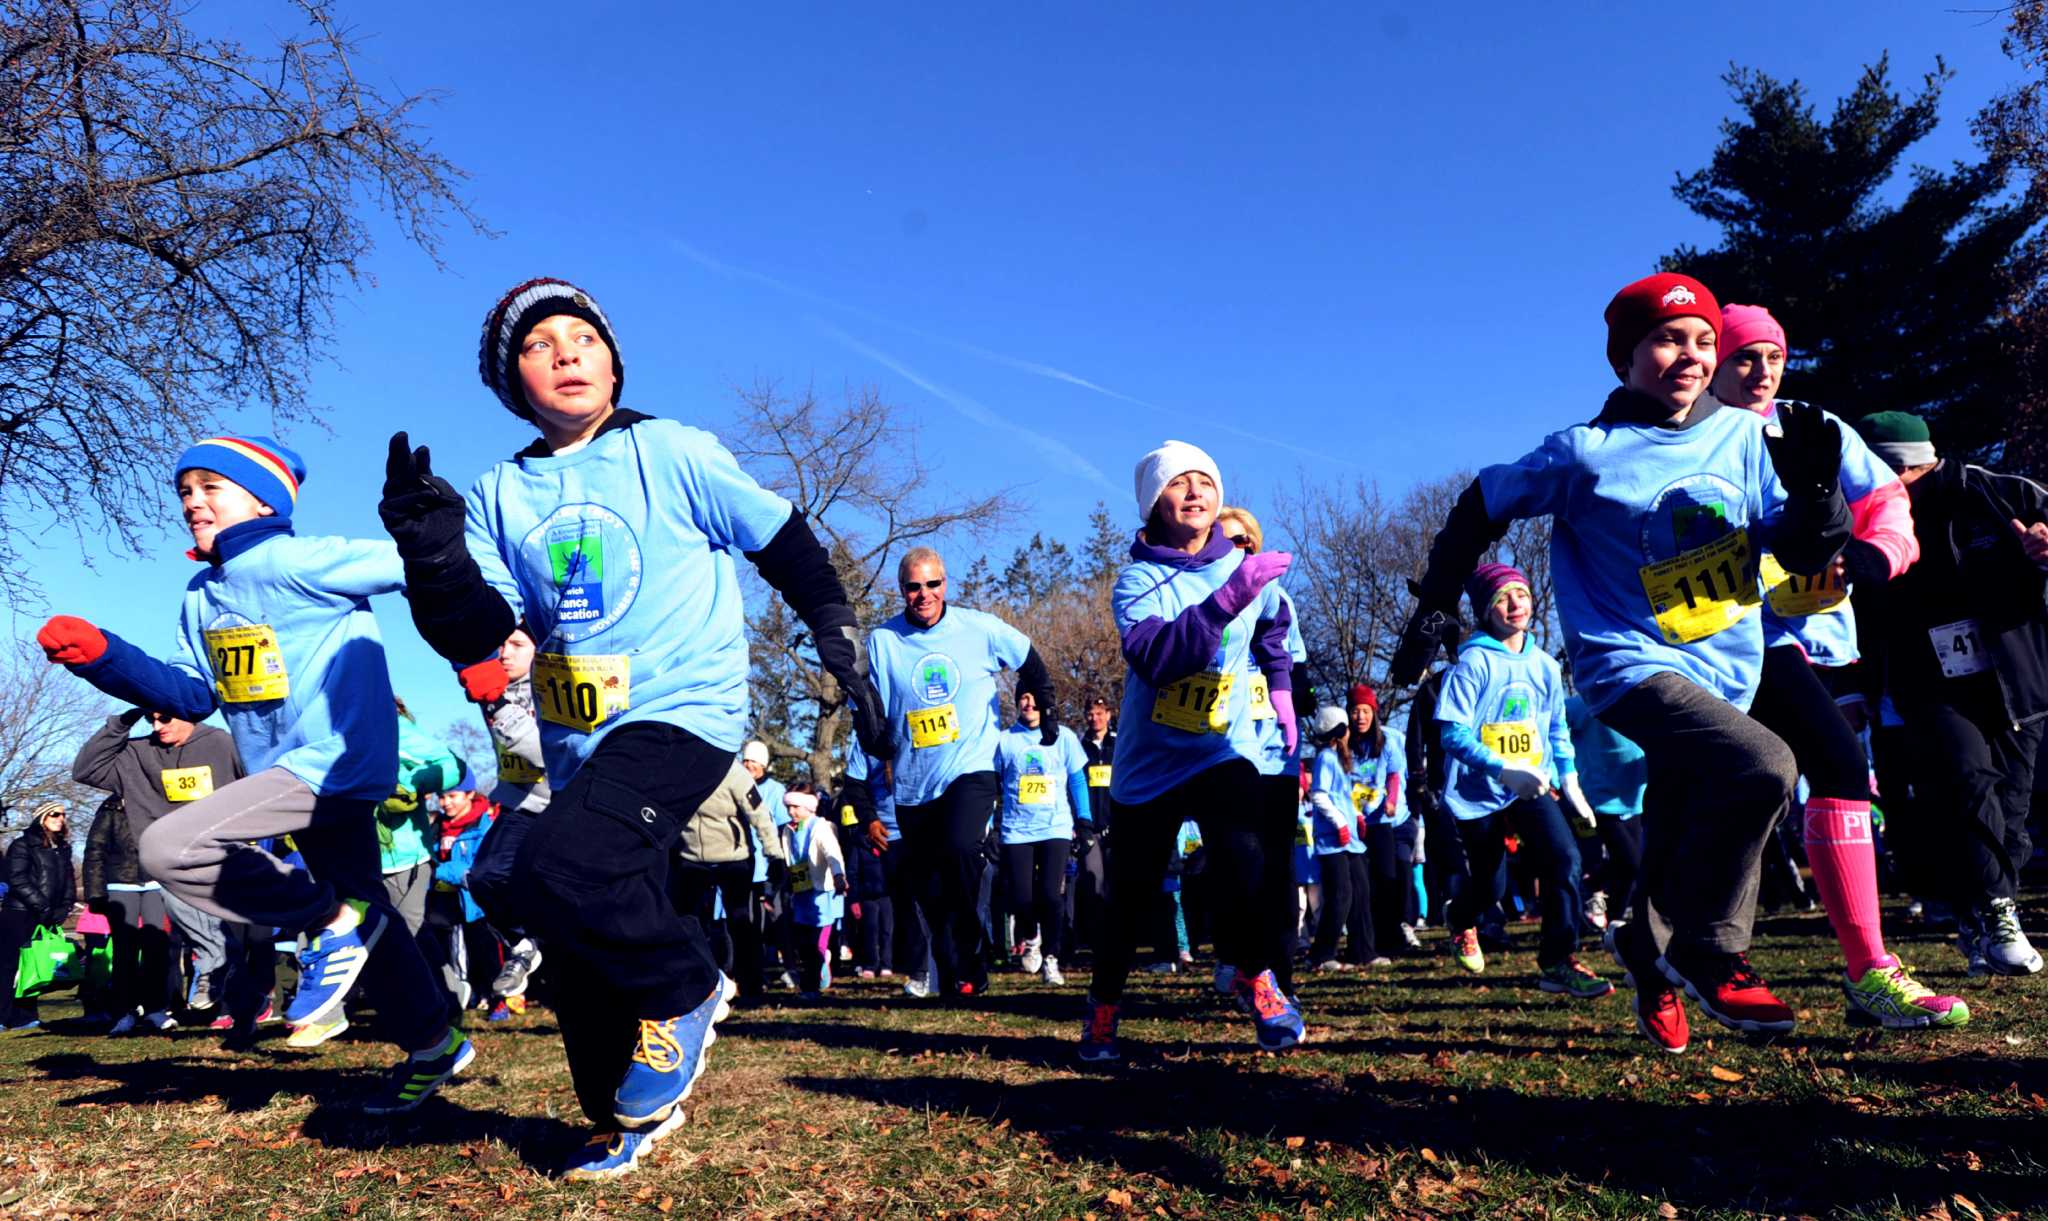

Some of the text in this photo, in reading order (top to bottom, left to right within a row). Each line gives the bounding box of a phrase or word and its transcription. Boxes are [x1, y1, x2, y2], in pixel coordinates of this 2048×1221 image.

[1674, 559, 1737, 610] 111
[1953, 631, 1979, 656] 41
[217, 645, 255, 677] 277
[546, 676, 598, 723] 110
[1178, 682, 1220, 713] 112
[919, 715, 947, 734] 114
[1497, 733, 1531, 754] 109
[178, 776, 197, 789] 33
[1026, 782, 1047, 794] 275
